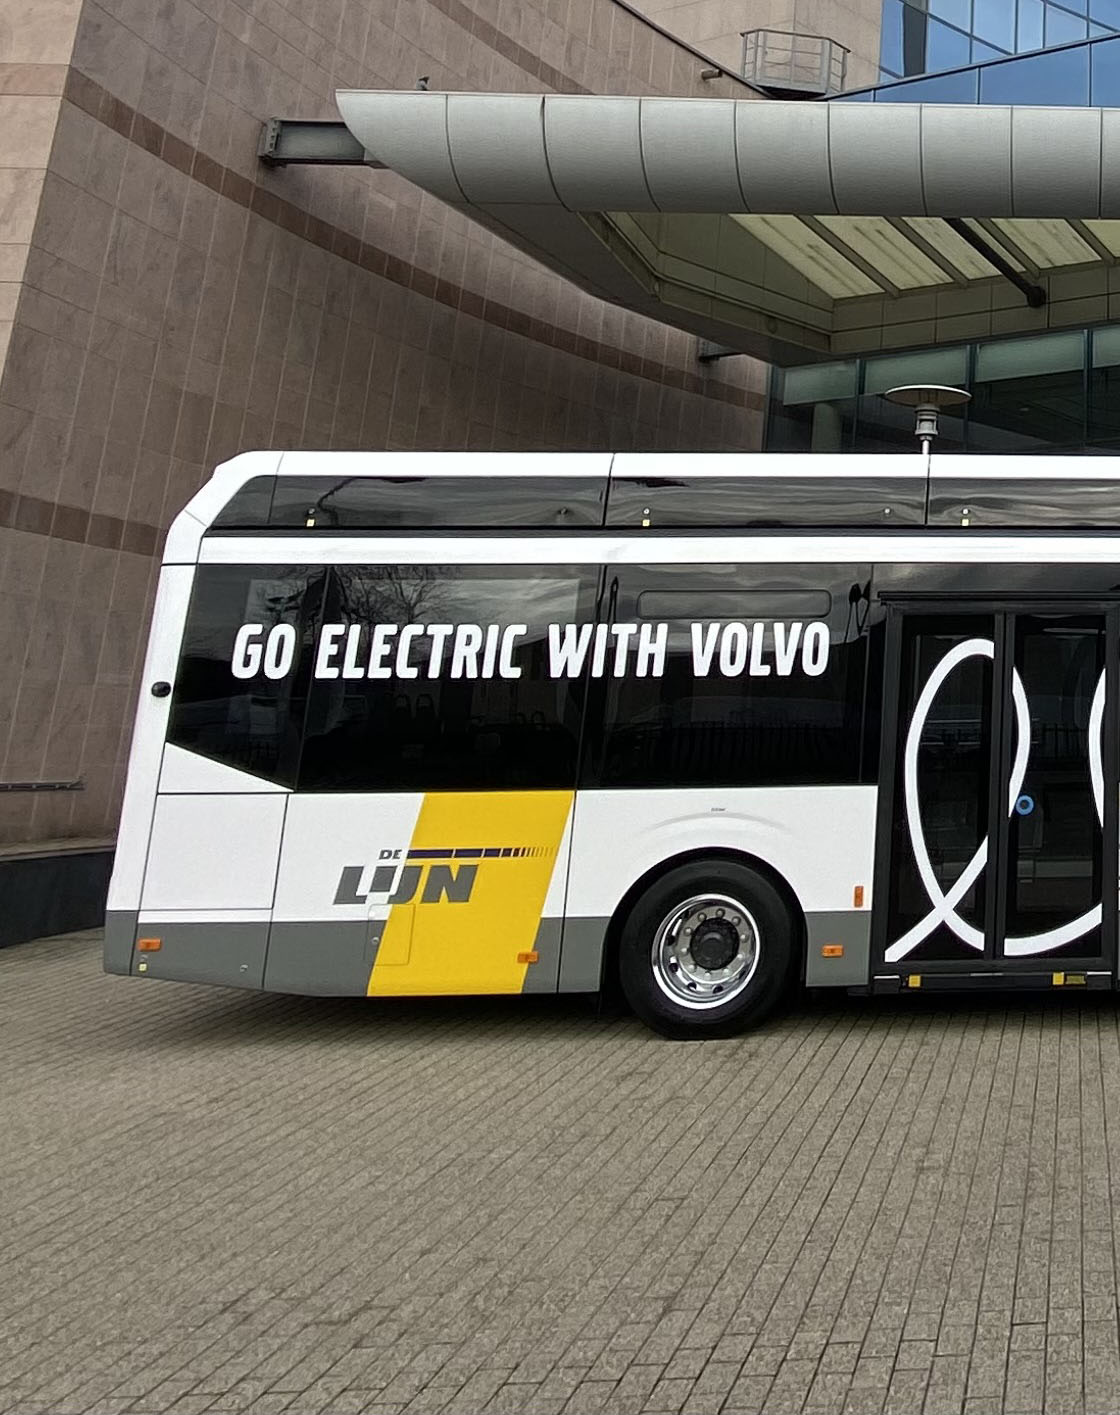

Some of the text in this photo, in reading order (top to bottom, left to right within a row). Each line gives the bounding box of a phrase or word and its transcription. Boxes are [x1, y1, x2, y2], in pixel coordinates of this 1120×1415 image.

[231, 622, 830, 680] GO ELECTRIC WITH VOLVO
[378, 849, 402, 860] DE
[333, 864, 479, 905] LIJN
